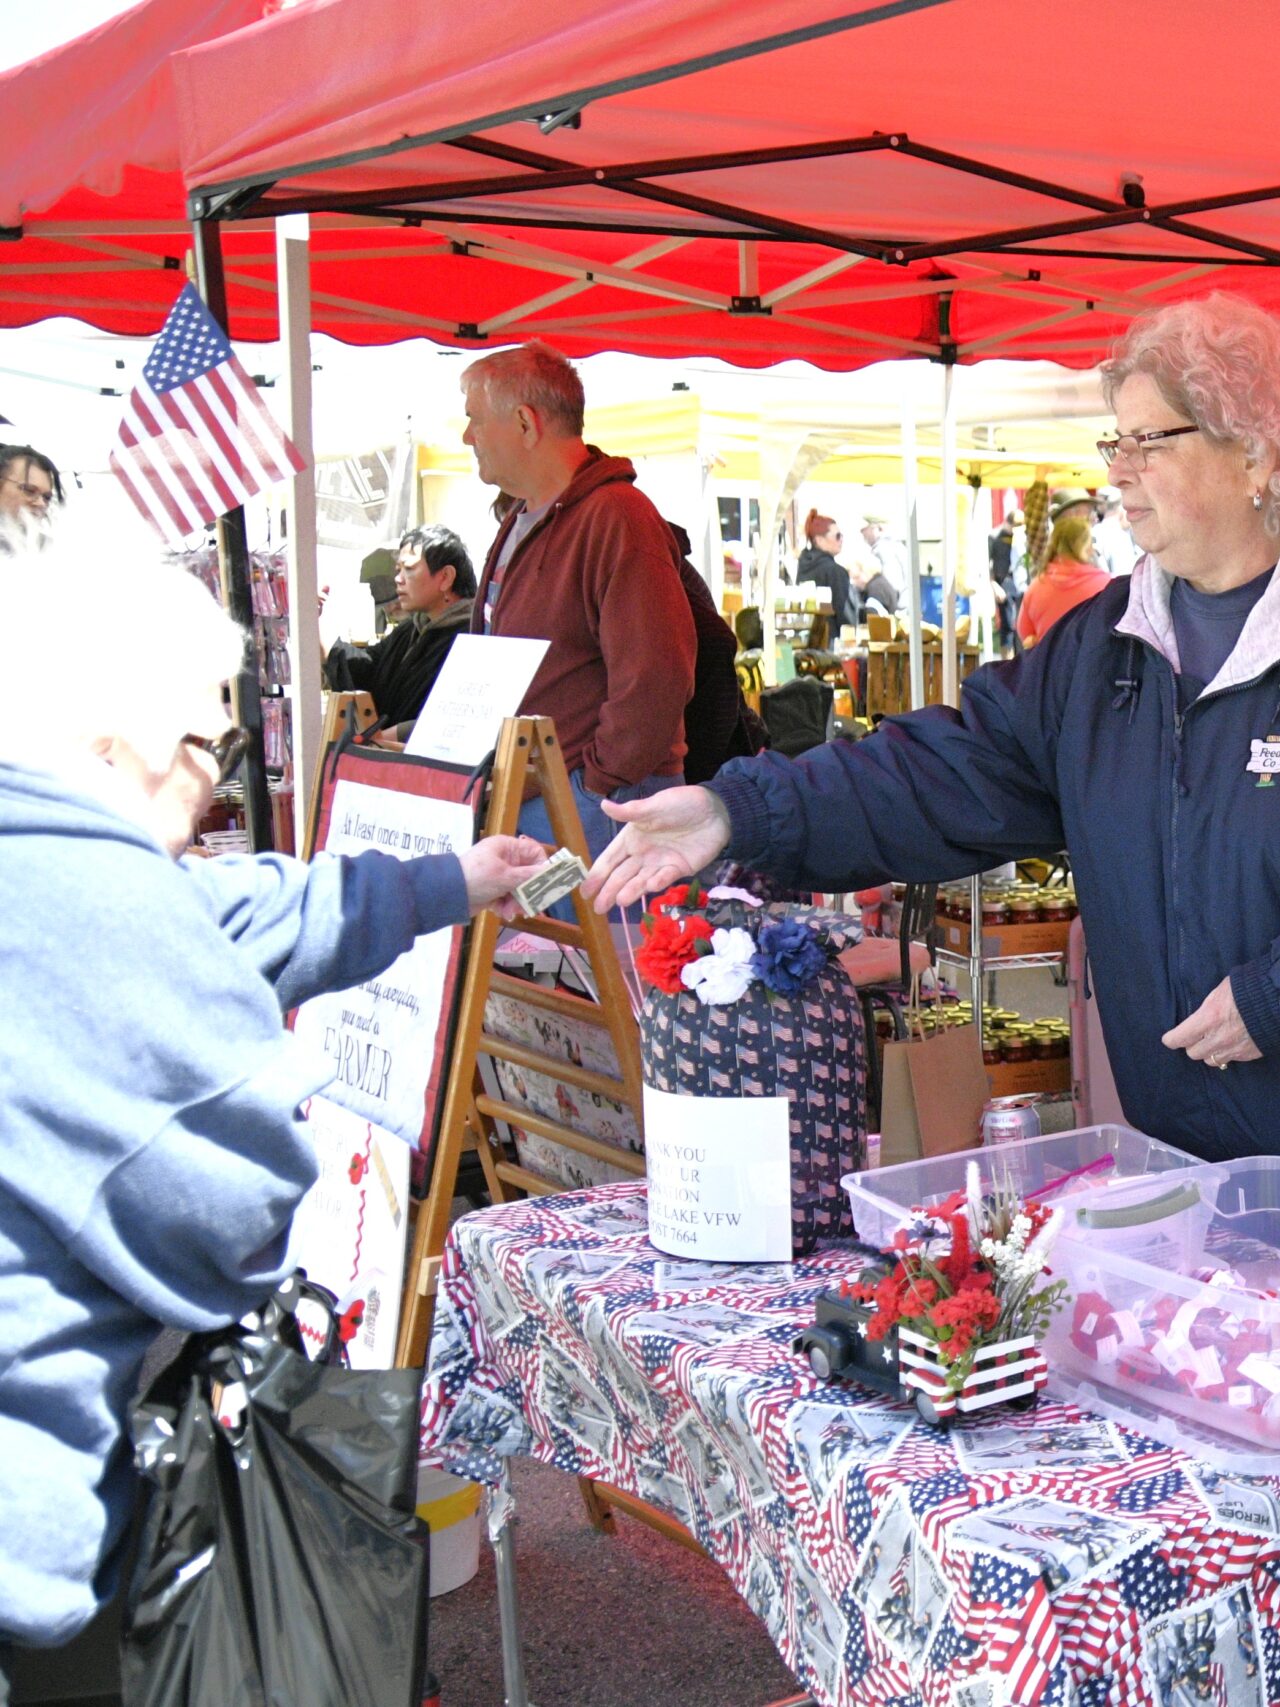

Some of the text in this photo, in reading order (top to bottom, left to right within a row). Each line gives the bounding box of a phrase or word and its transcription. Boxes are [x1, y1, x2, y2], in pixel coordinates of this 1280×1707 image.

[1263, 758, 1276, 767] Co
[340, 812, 352, 835] At
[354, 813, 376, 841] least
[377, 827, 399, 847] once
[401, 827, 411, 850] in
[356, 1011, 375, 1032] need
[373, 1022, 380, 1035] a
[324, 1027, 392, 1101] FARMER
[674, 1145, 706, 1163] YOU
[664, 1204, 700, 1225] LAKE
[703, 1211, 742, 1227] VFW
[651, 1218, 697, 1244] OST 7664
[1218, 1508, 1269, 1526] HEROES
